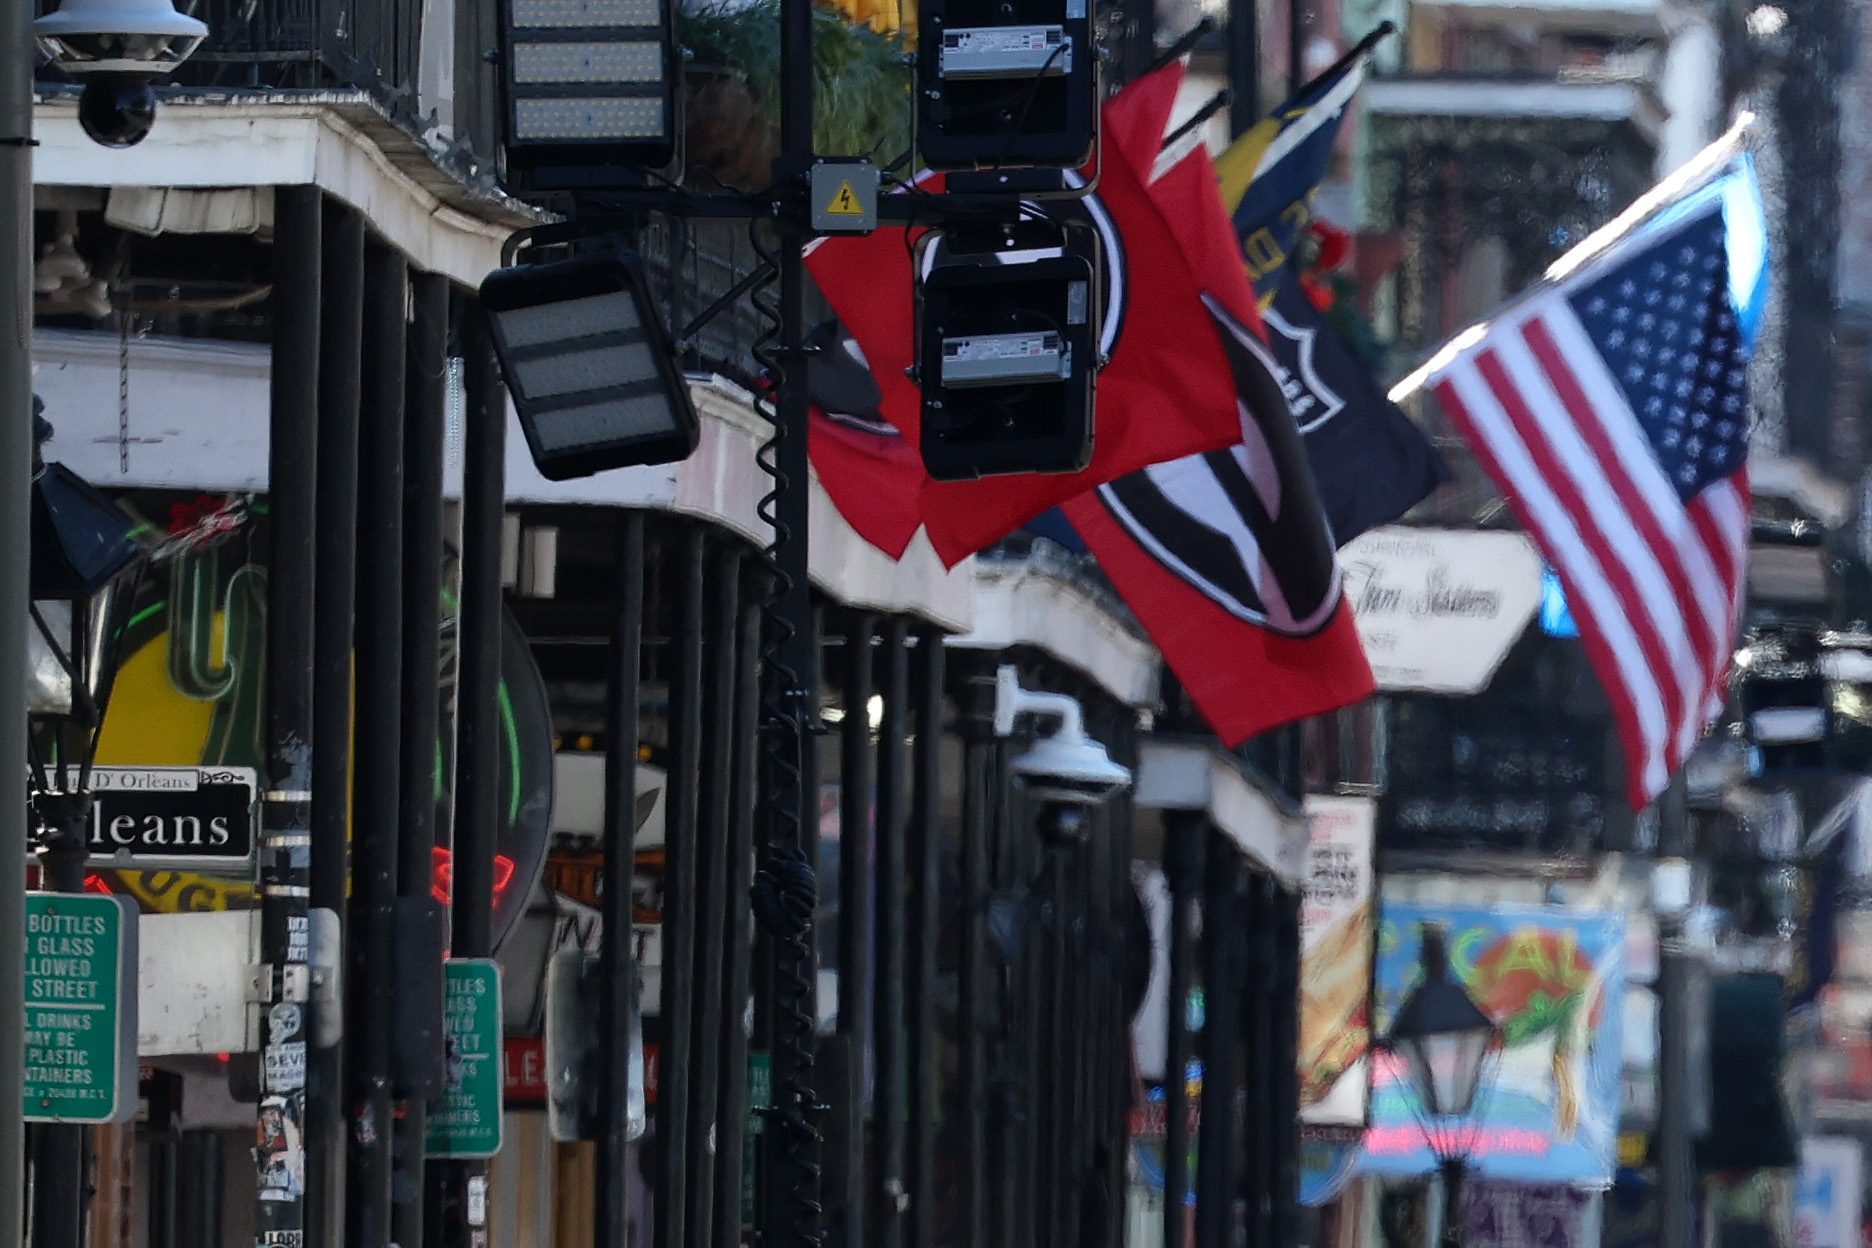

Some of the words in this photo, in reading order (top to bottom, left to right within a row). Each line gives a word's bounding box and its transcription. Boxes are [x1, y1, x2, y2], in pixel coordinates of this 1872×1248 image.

[90, 799, 229, 845] leans
[28, 914, 106, 935] BOTTLES
[37, 936, 95, 957] GLASS
[26, 957, 91, 978] LOWED
[32, 979, 98, 999] STREET
[36, 1012, 92, 1031] DRINKS
[29, 1049, 88, 1066] PLASTIC
[25, 1068, 92, 1084] NTAINERS
